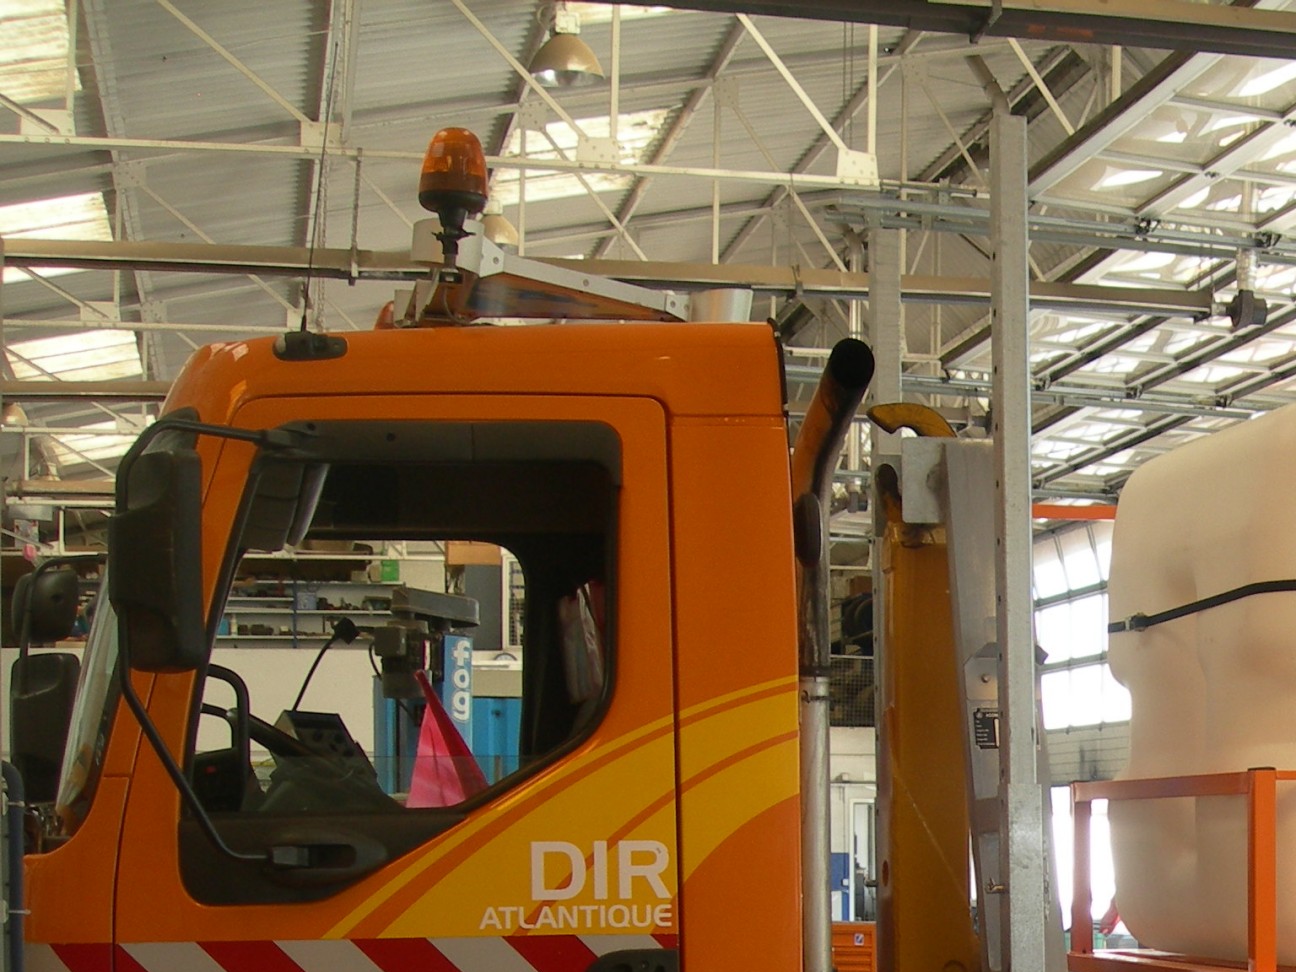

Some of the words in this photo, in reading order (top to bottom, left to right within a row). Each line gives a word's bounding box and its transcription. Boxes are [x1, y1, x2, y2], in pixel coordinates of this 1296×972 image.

[453, 641, 470, 720] fog
[530, 839, 673, 901] DIR
[479, 903, 672, 930] ATLANTIQUE
